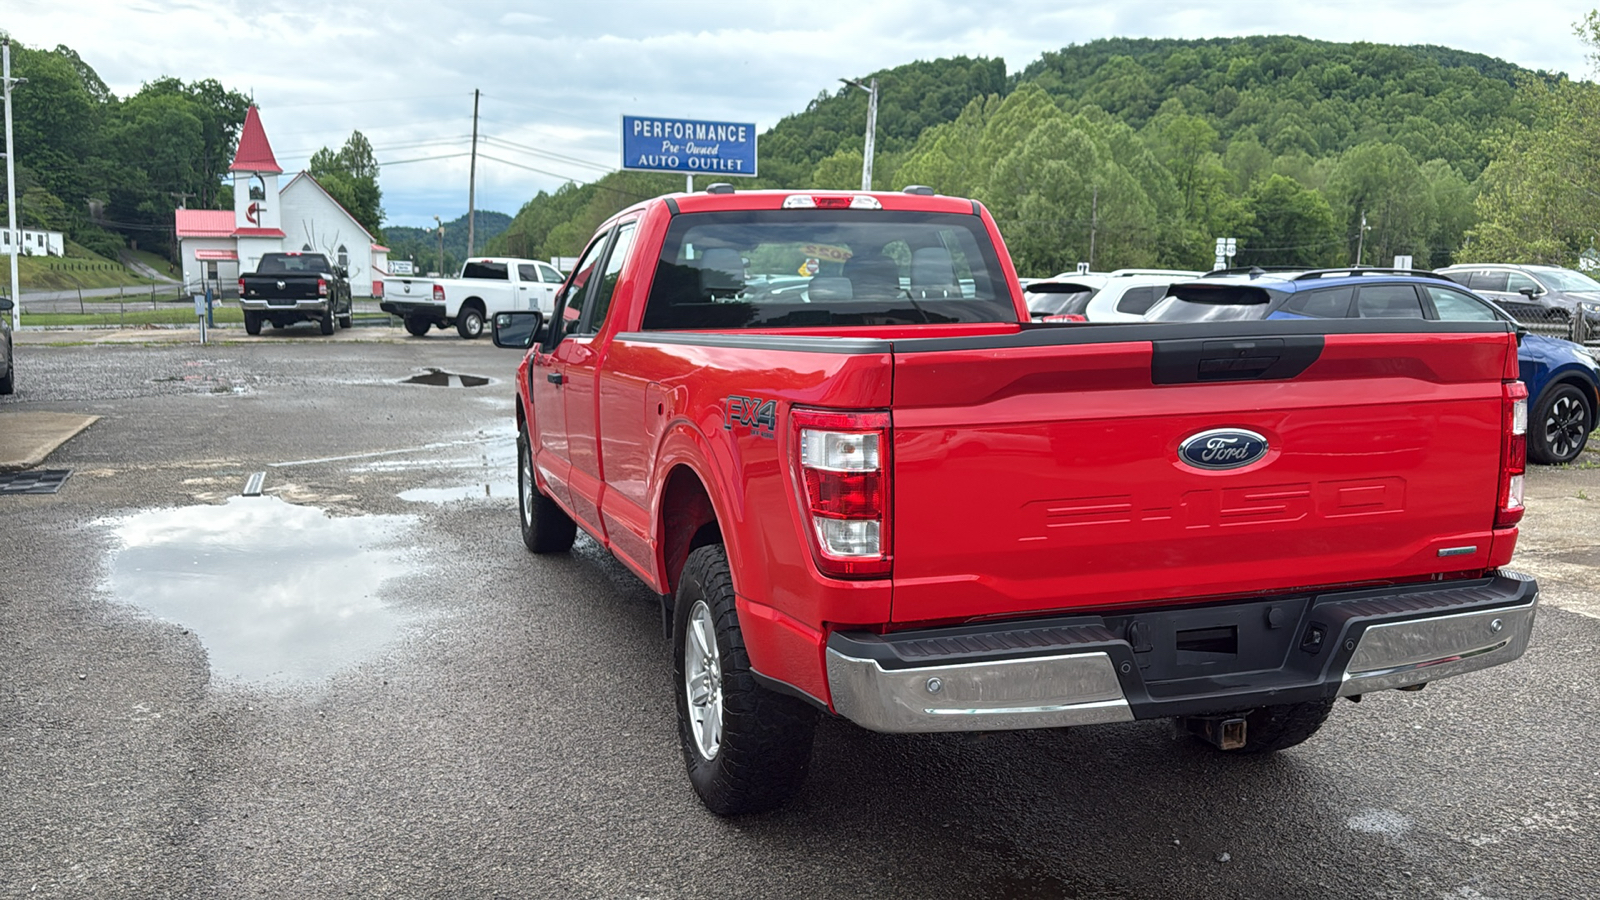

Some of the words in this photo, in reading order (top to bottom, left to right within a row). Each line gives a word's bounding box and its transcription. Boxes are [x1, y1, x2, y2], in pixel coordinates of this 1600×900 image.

[633, 120, 746, 142] PERFORMANCE
[661, 140, 719, 155] Pre-Owned
[638, 154, 680, 167] AUTO
[688, 156, 743, 171] OUTLET
[724, 395, 776, 430] FX4
[1201, 437, 1250, 461] Ford
[1018, 476, 1407, 541] F-150
